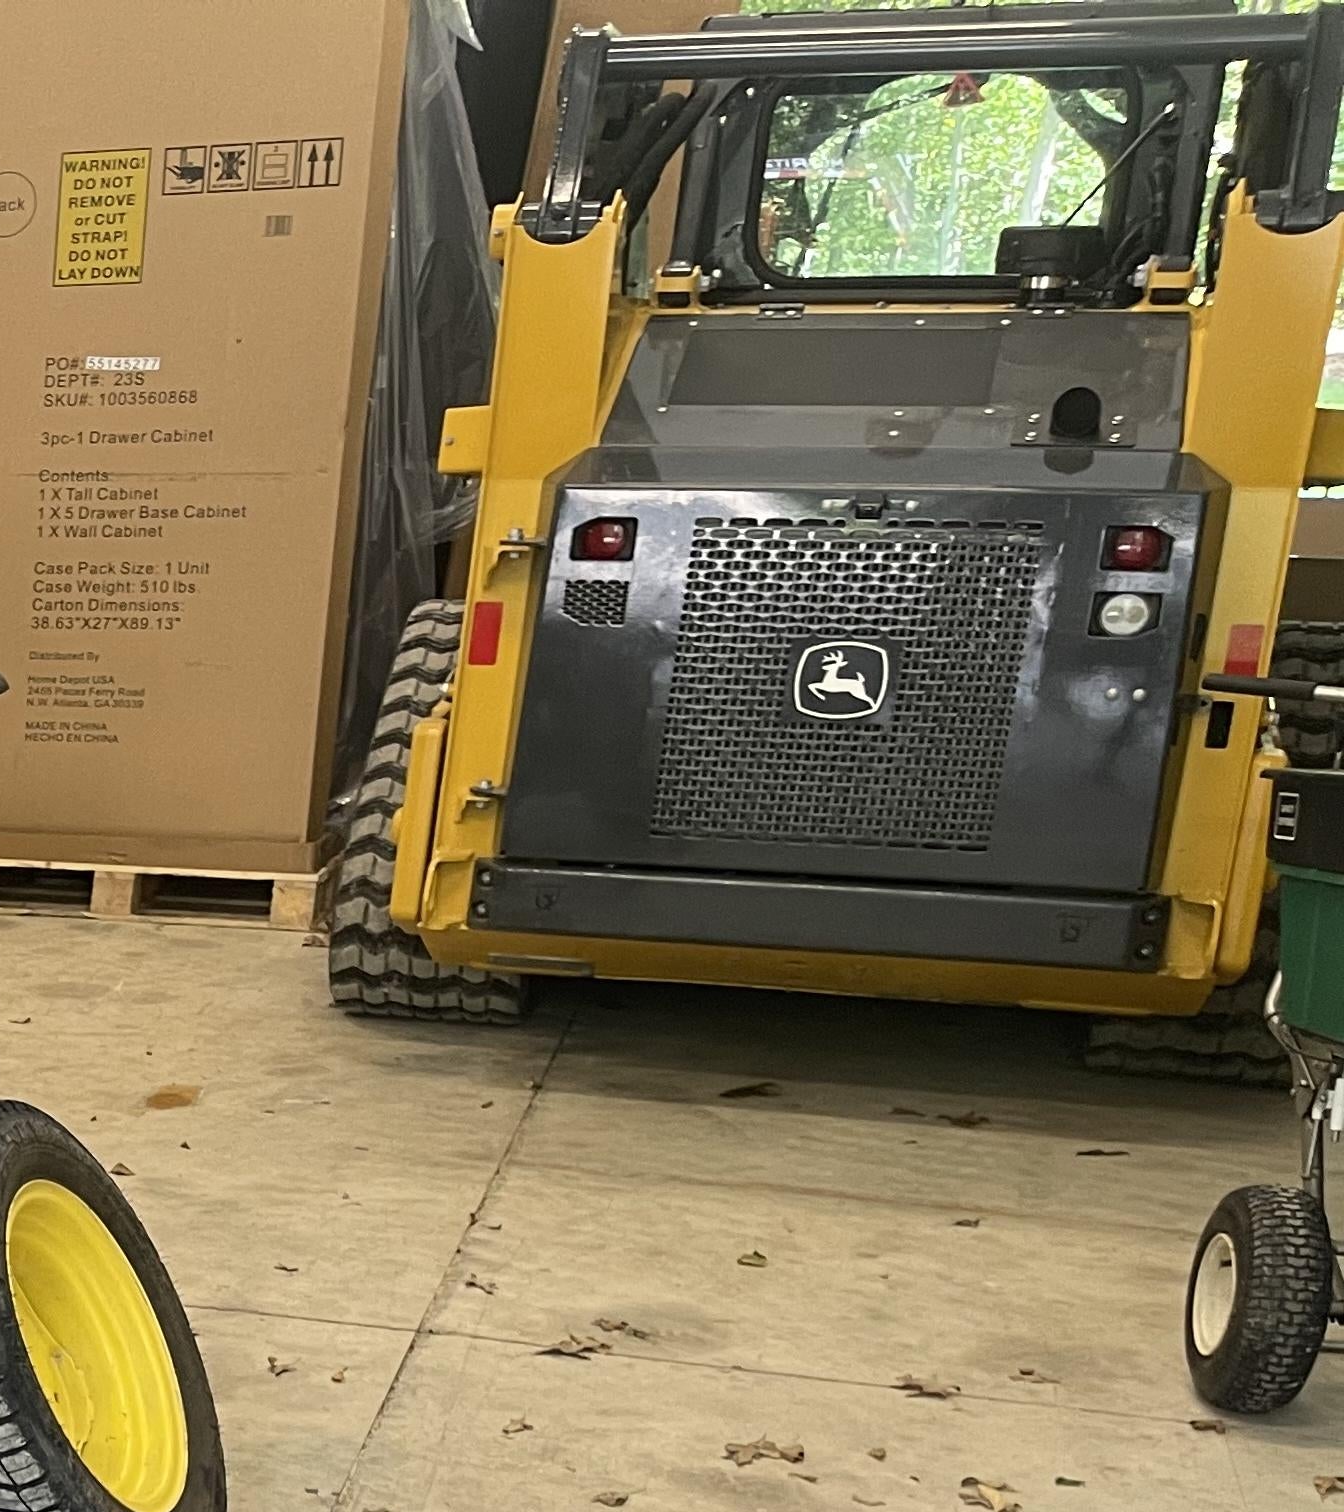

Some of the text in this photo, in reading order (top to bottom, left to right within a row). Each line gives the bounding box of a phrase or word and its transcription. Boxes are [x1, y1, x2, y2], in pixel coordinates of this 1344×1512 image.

[64, 157, 146, 173] WARNING!
[73, 176, 134, 191] DO NOT
[68, 194, 136, 209] REMOVE
[74, 212, 127, 227] or CUT
[70, 230, 128, 244] STRAP!
[68, 248, 128, 262] DO NOT
[58, 266, 141, 281] LAY DOWN
[113, 371, 145, 386] 23S
[99, 390, 197, 406] 1003560868
[40, 428, 213, 447] 3pc-1 Drawer Cabinet
[39, 486, 158, 501] 1 X Tall Cabinet
[37, 504, 247, 520] 1 X 5 Drawer Base Cabinet
[37, 524, 163, 538] 1 X Wall Cabinet
[33, 562, 73, 575] Case
[78, 562, 114, 575] Pack
[165, 562, 172, 574] 1
[178, 561, 210, 575] Unit
[32, 580, 72, 594] Case
[77, 580, 135, 596] Weight:
[140, 580, 169, 593] 510
[32, 598, 184, 612] Carton Dimensions:
[25, 721, 108, 731] MADE IN CHINA
[24, 733, 119, 743] HECHO EN CHINA
